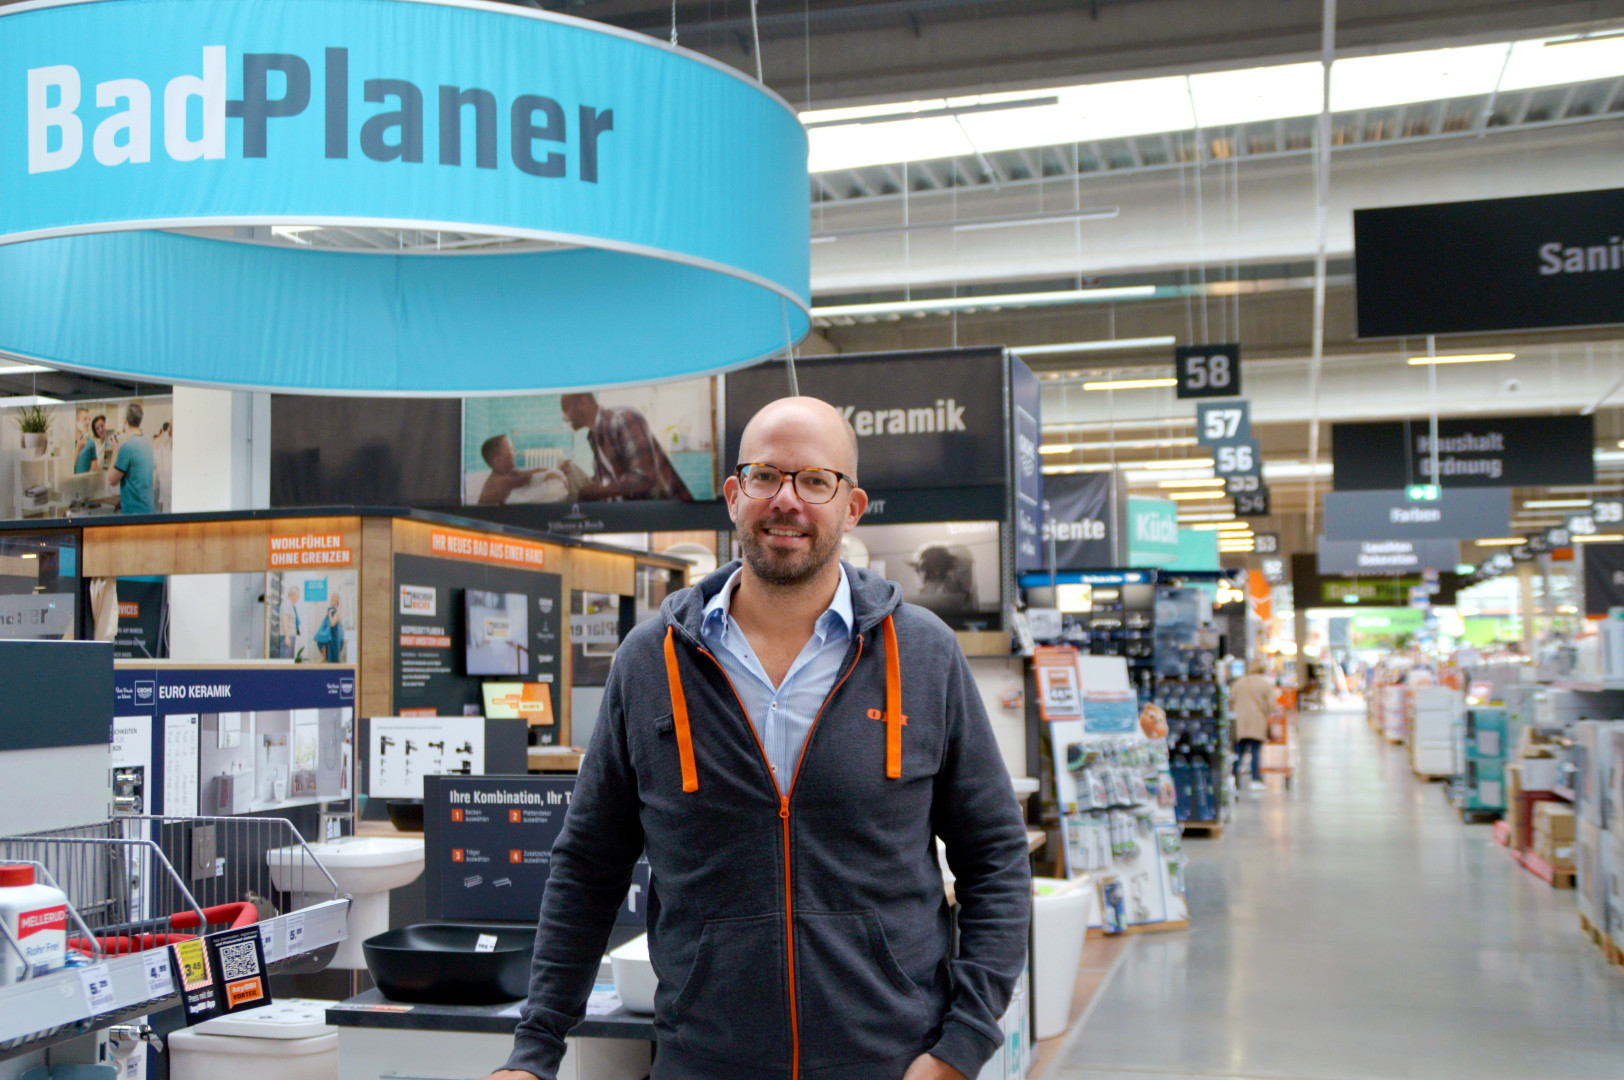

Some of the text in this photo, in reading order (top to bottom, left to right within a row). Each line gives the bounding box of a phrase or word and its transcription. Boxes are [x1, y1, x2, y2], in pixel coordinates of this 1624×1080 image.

[1538, 235, 1624, 276] Sani
[1185, 355, 1230, 390] 58
[1204, 409, 1242, 439] 57
[1217, 445, 1253, 472] 56
[271, 534, 341, 550] WOHLFÜHLEN
[432, 533, 543, 564] IHR NEUES BAD AUS EINER HAND
[271, 550, 350, 565] OHNE GRENZEN
[118, 604, 138, 616] VICES
[159, 685, 232, 699] EURO KERAMIK
[449, 790, 471, 804] Ihre
[473, 790, 544, 806] Kombination,
[547, 791, 562, 804] Ihr
[21, 910, 66, 929] MELLERUD
